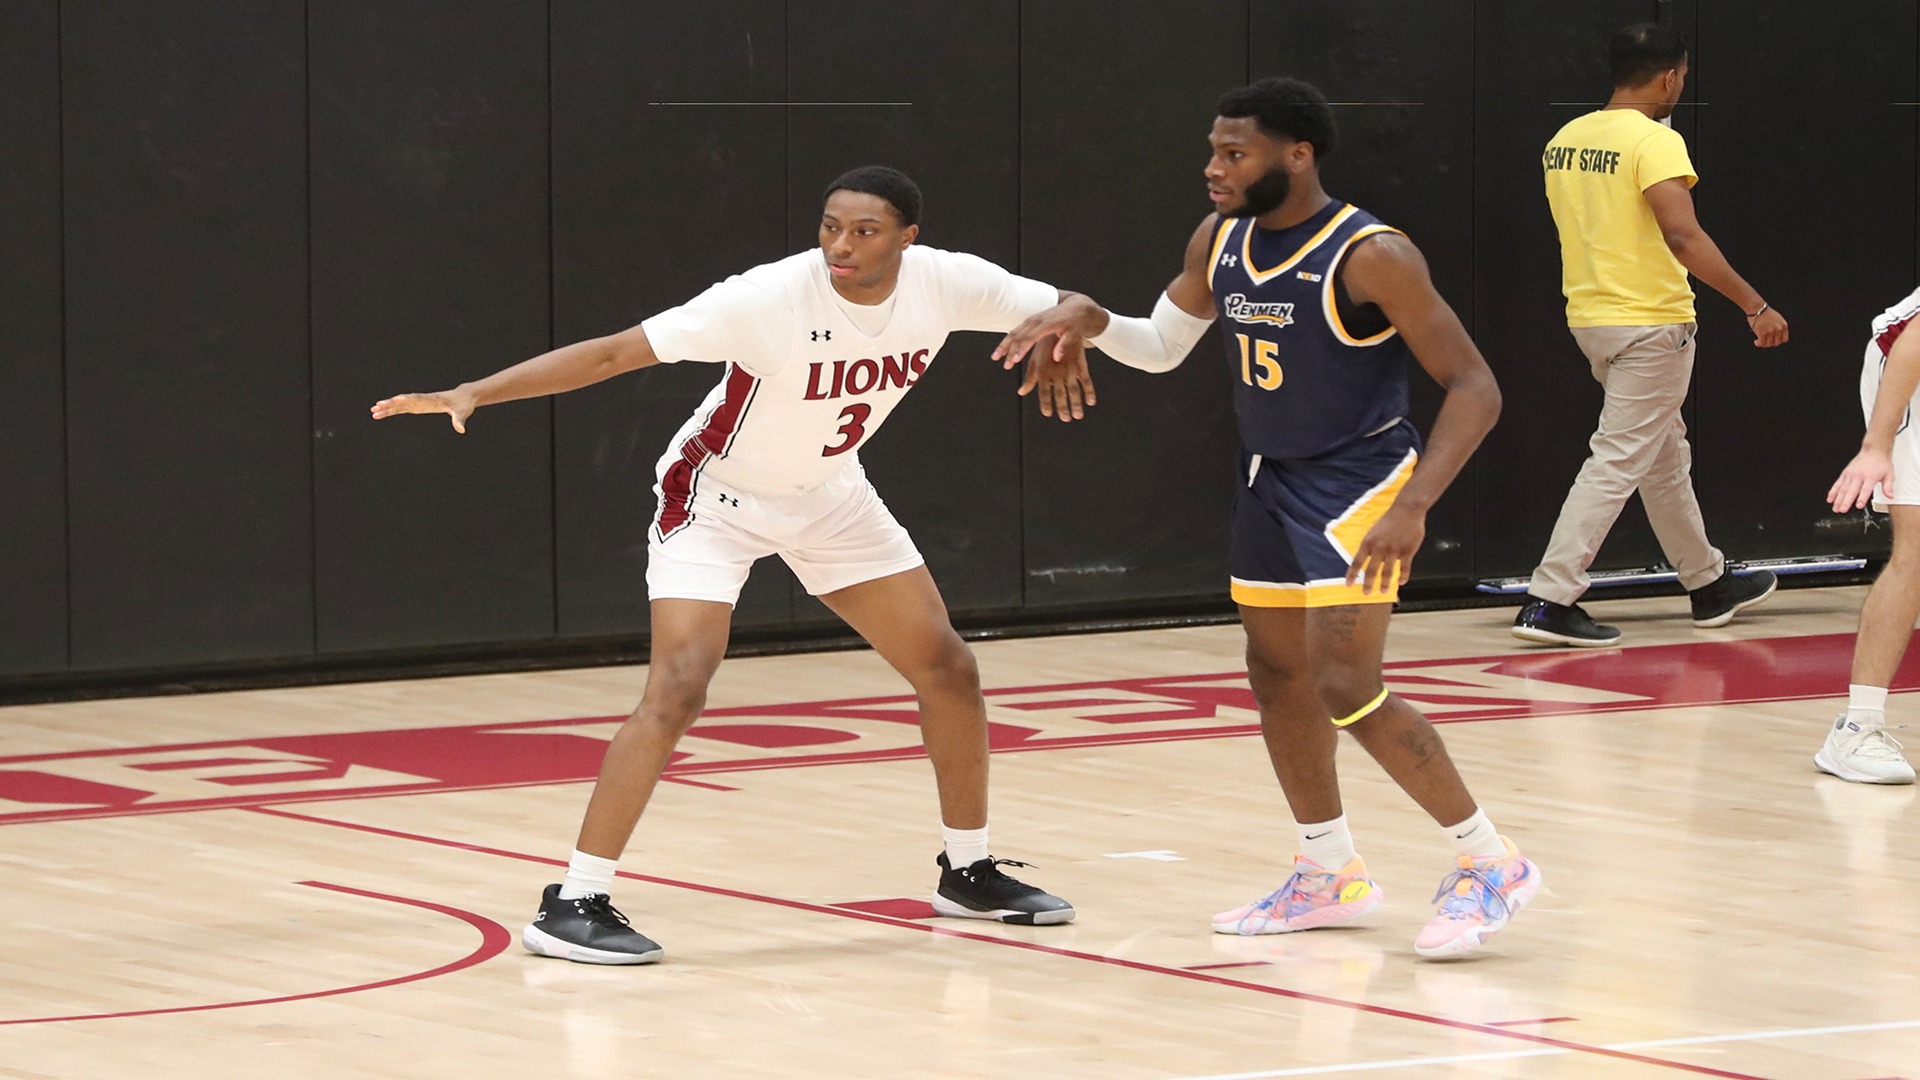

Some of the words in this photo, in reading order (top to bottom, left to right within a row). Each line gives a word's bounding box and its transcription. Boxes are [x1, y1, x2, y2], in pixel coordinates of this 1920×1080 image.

[1580, 148, 1621, 175] STAFF
[803, 349, 929, 400] LIONS
[1235, 333, 1284, 391] 15
[822, 403, 872, 457] 3
